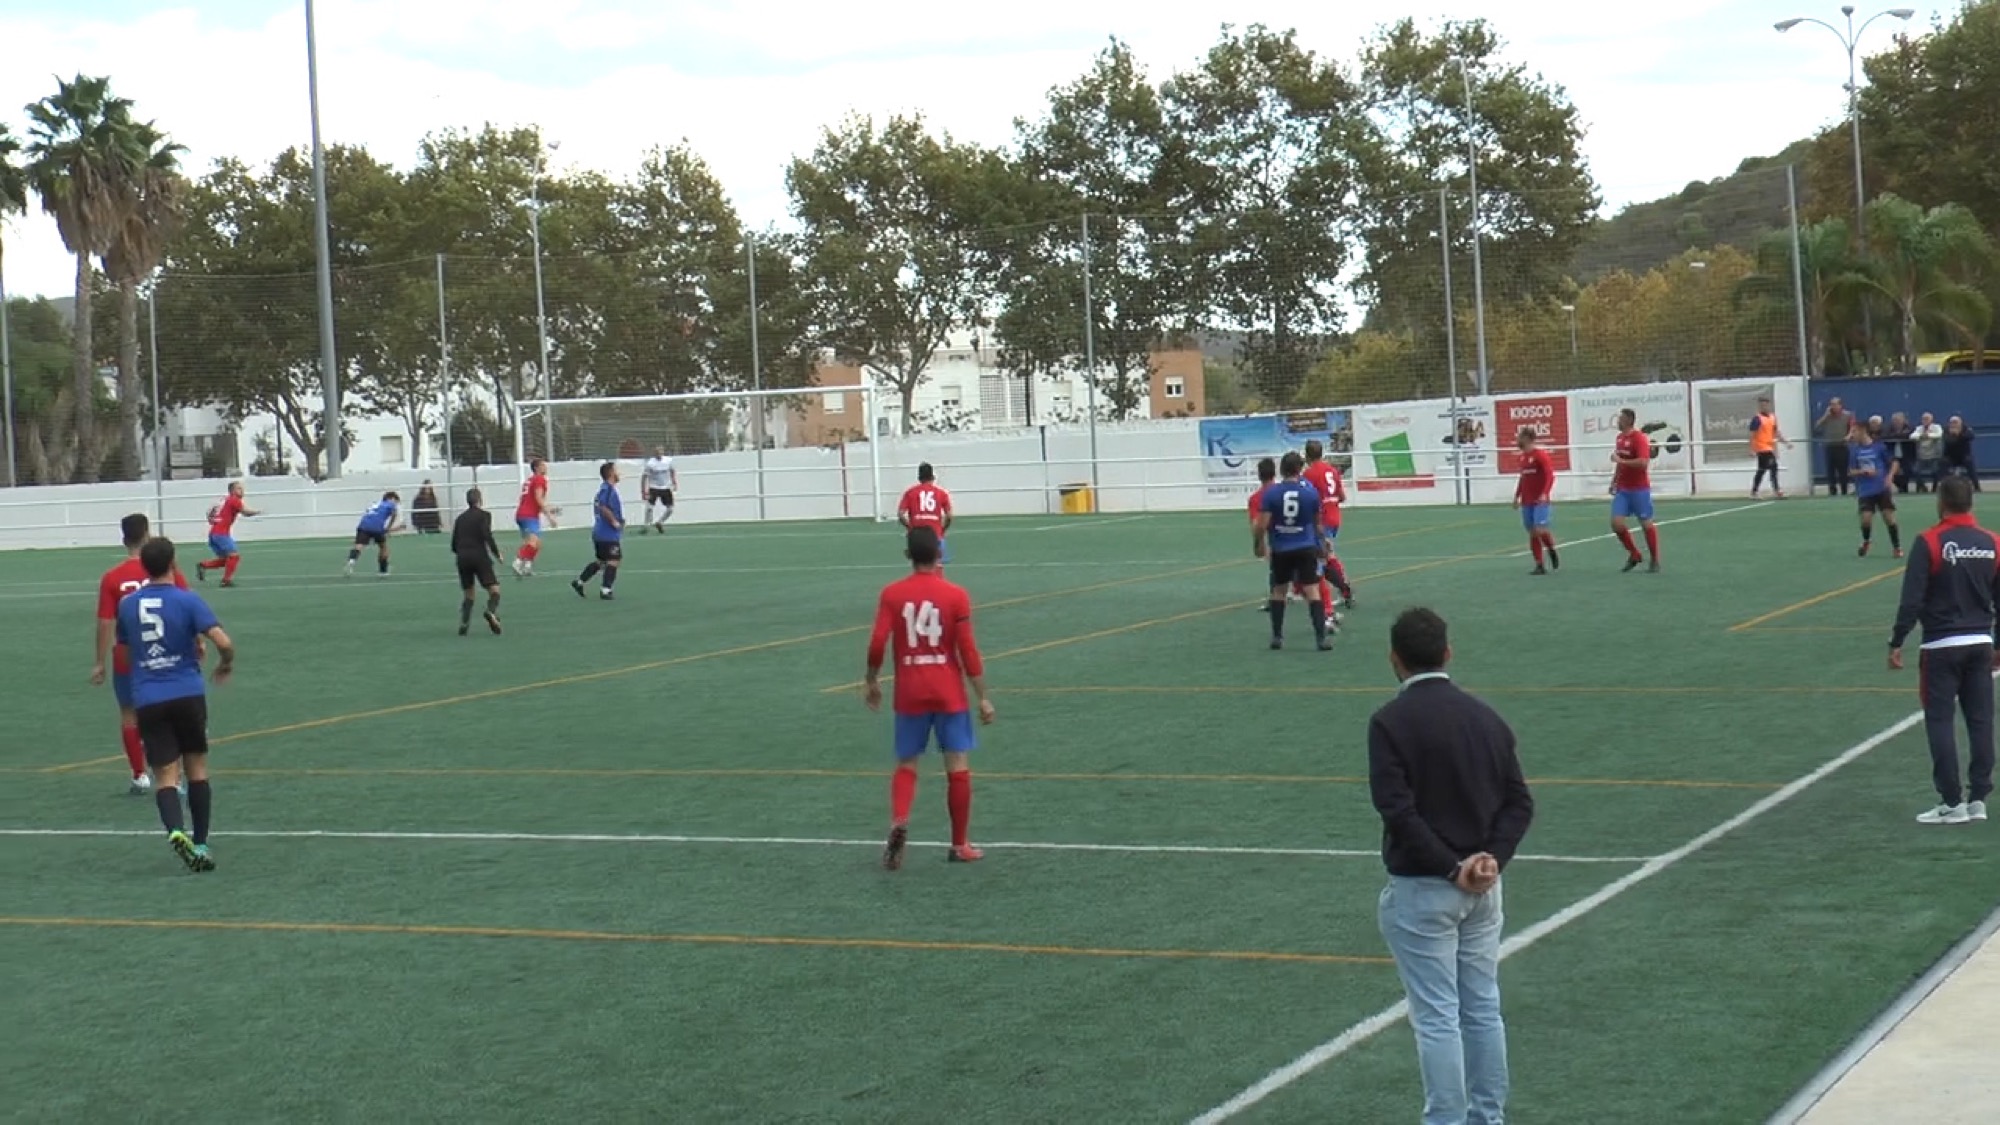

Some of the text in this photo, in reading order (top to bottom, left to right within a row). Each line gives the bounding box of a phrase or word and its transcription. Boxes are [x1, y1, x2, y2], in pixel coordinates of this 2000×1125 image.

[1510, 405, 1553, 420] KIOSCO
[919, 491, 936, 511] 16
[1283, 491, 1299, 517] 6
[139, 598, 164, 641] 5
[903, 600, 942, 647] 14
